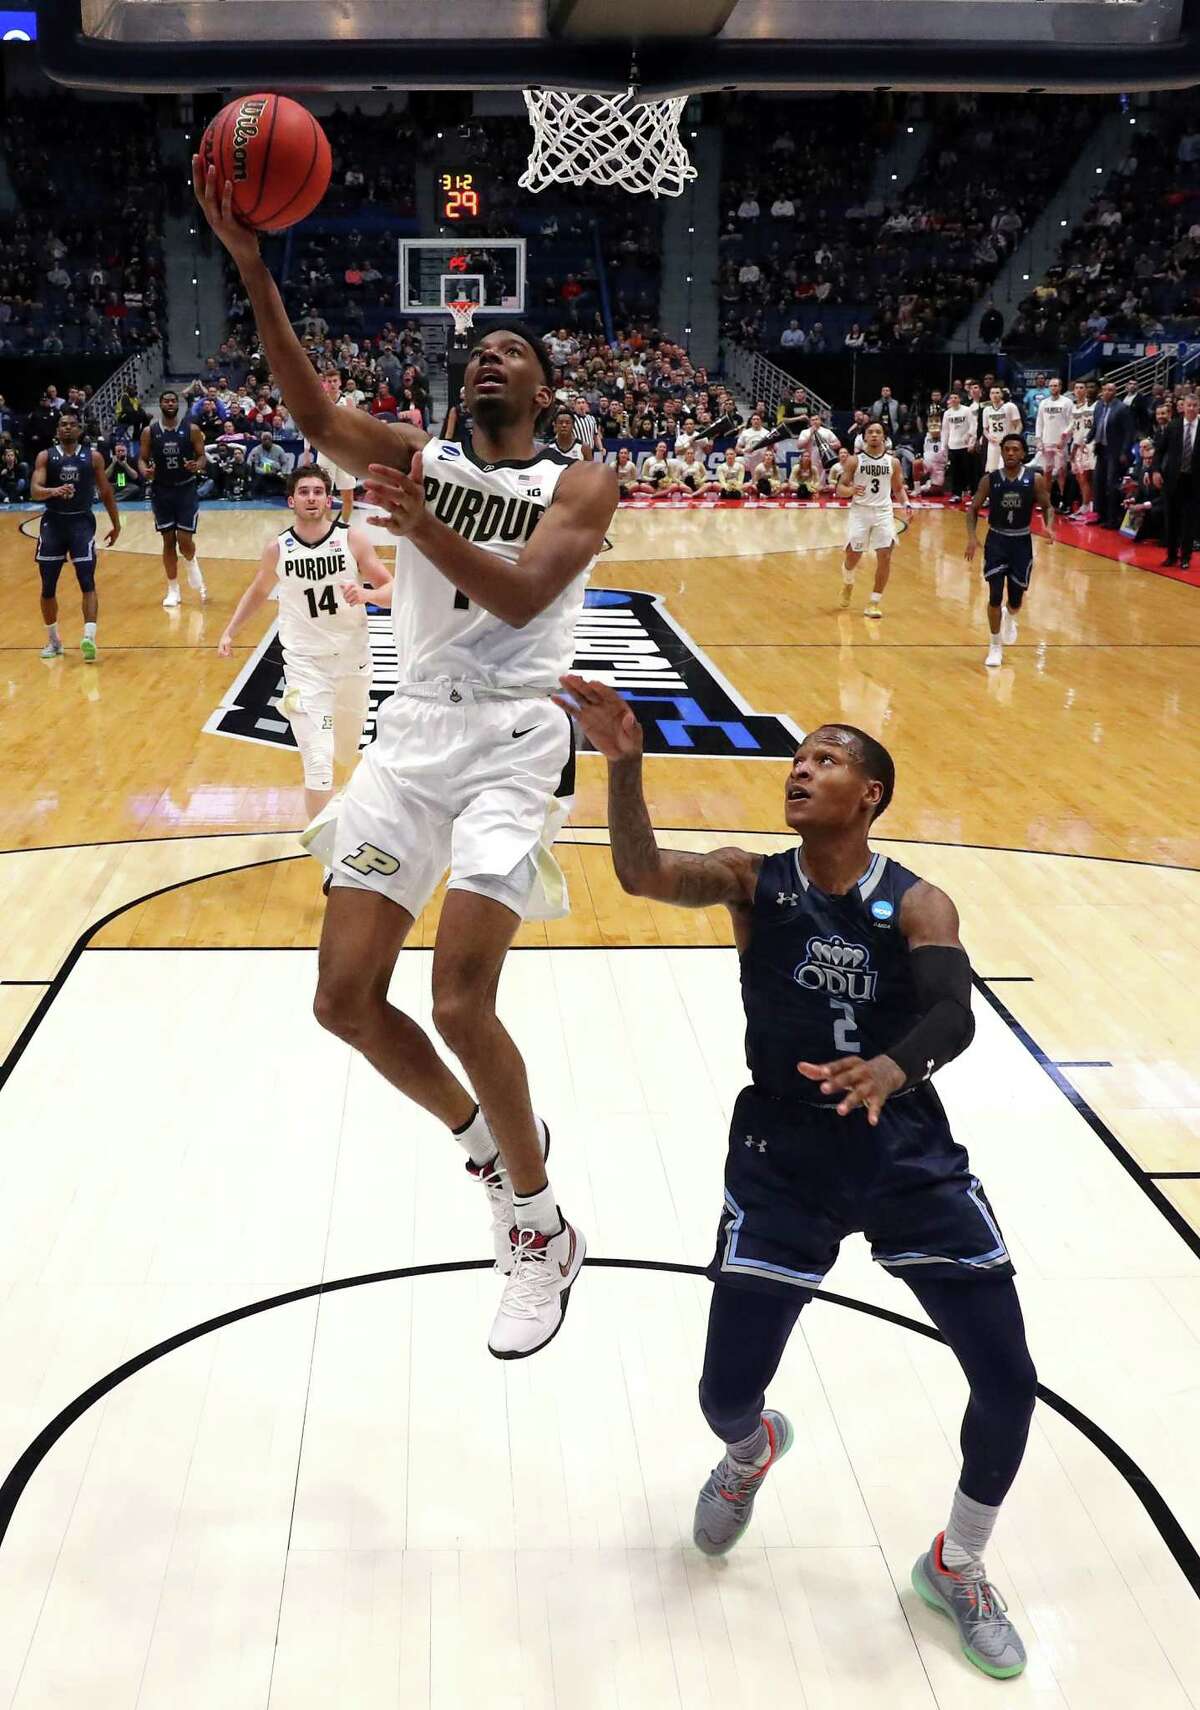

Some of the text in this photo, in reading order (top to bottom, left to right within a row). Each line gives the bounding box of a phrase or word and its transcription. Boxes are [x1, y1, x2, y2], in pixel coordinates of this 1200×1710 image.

[232, 99, 268, 182] Wilson
[445, 190, 478, 218] 29
[860, 465, 890, 476] PURDUE
[870, 478, 881, 494] 3
[284, 554, 347, 581] PURDUE
[303, 585, 338, 618] 14
[340, 841, 400, 877] P
[796, 964, 873, 1003] ODU
[830, 1000, 861, 1053] 2
